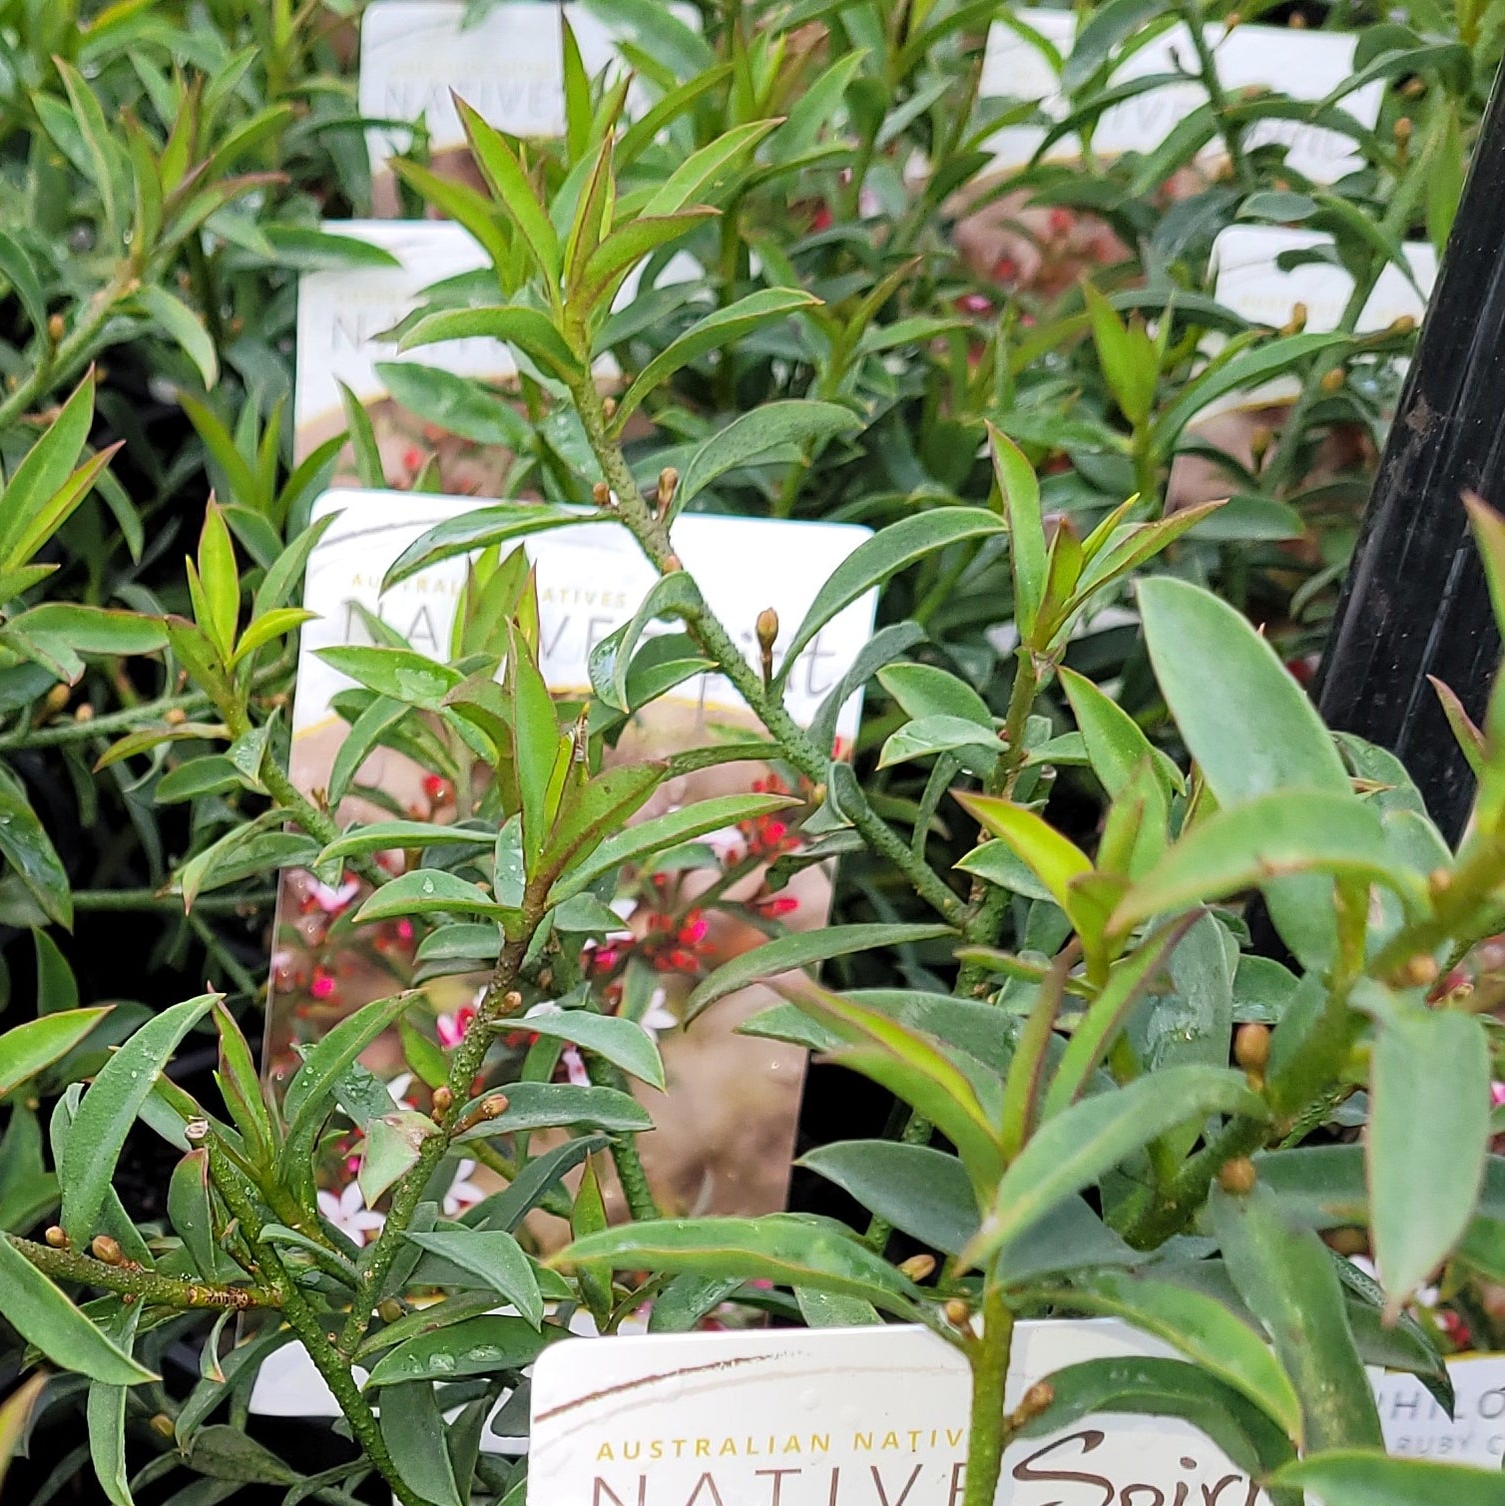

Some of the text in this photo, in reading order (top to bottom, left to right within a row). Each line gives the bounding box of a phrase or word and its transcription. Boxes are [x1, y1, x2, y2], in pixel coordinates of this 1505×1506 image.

[541, 585, 626, 608] ATIVES
[596, 1428, 964, 1462] AUSTRALIAN NATIV
